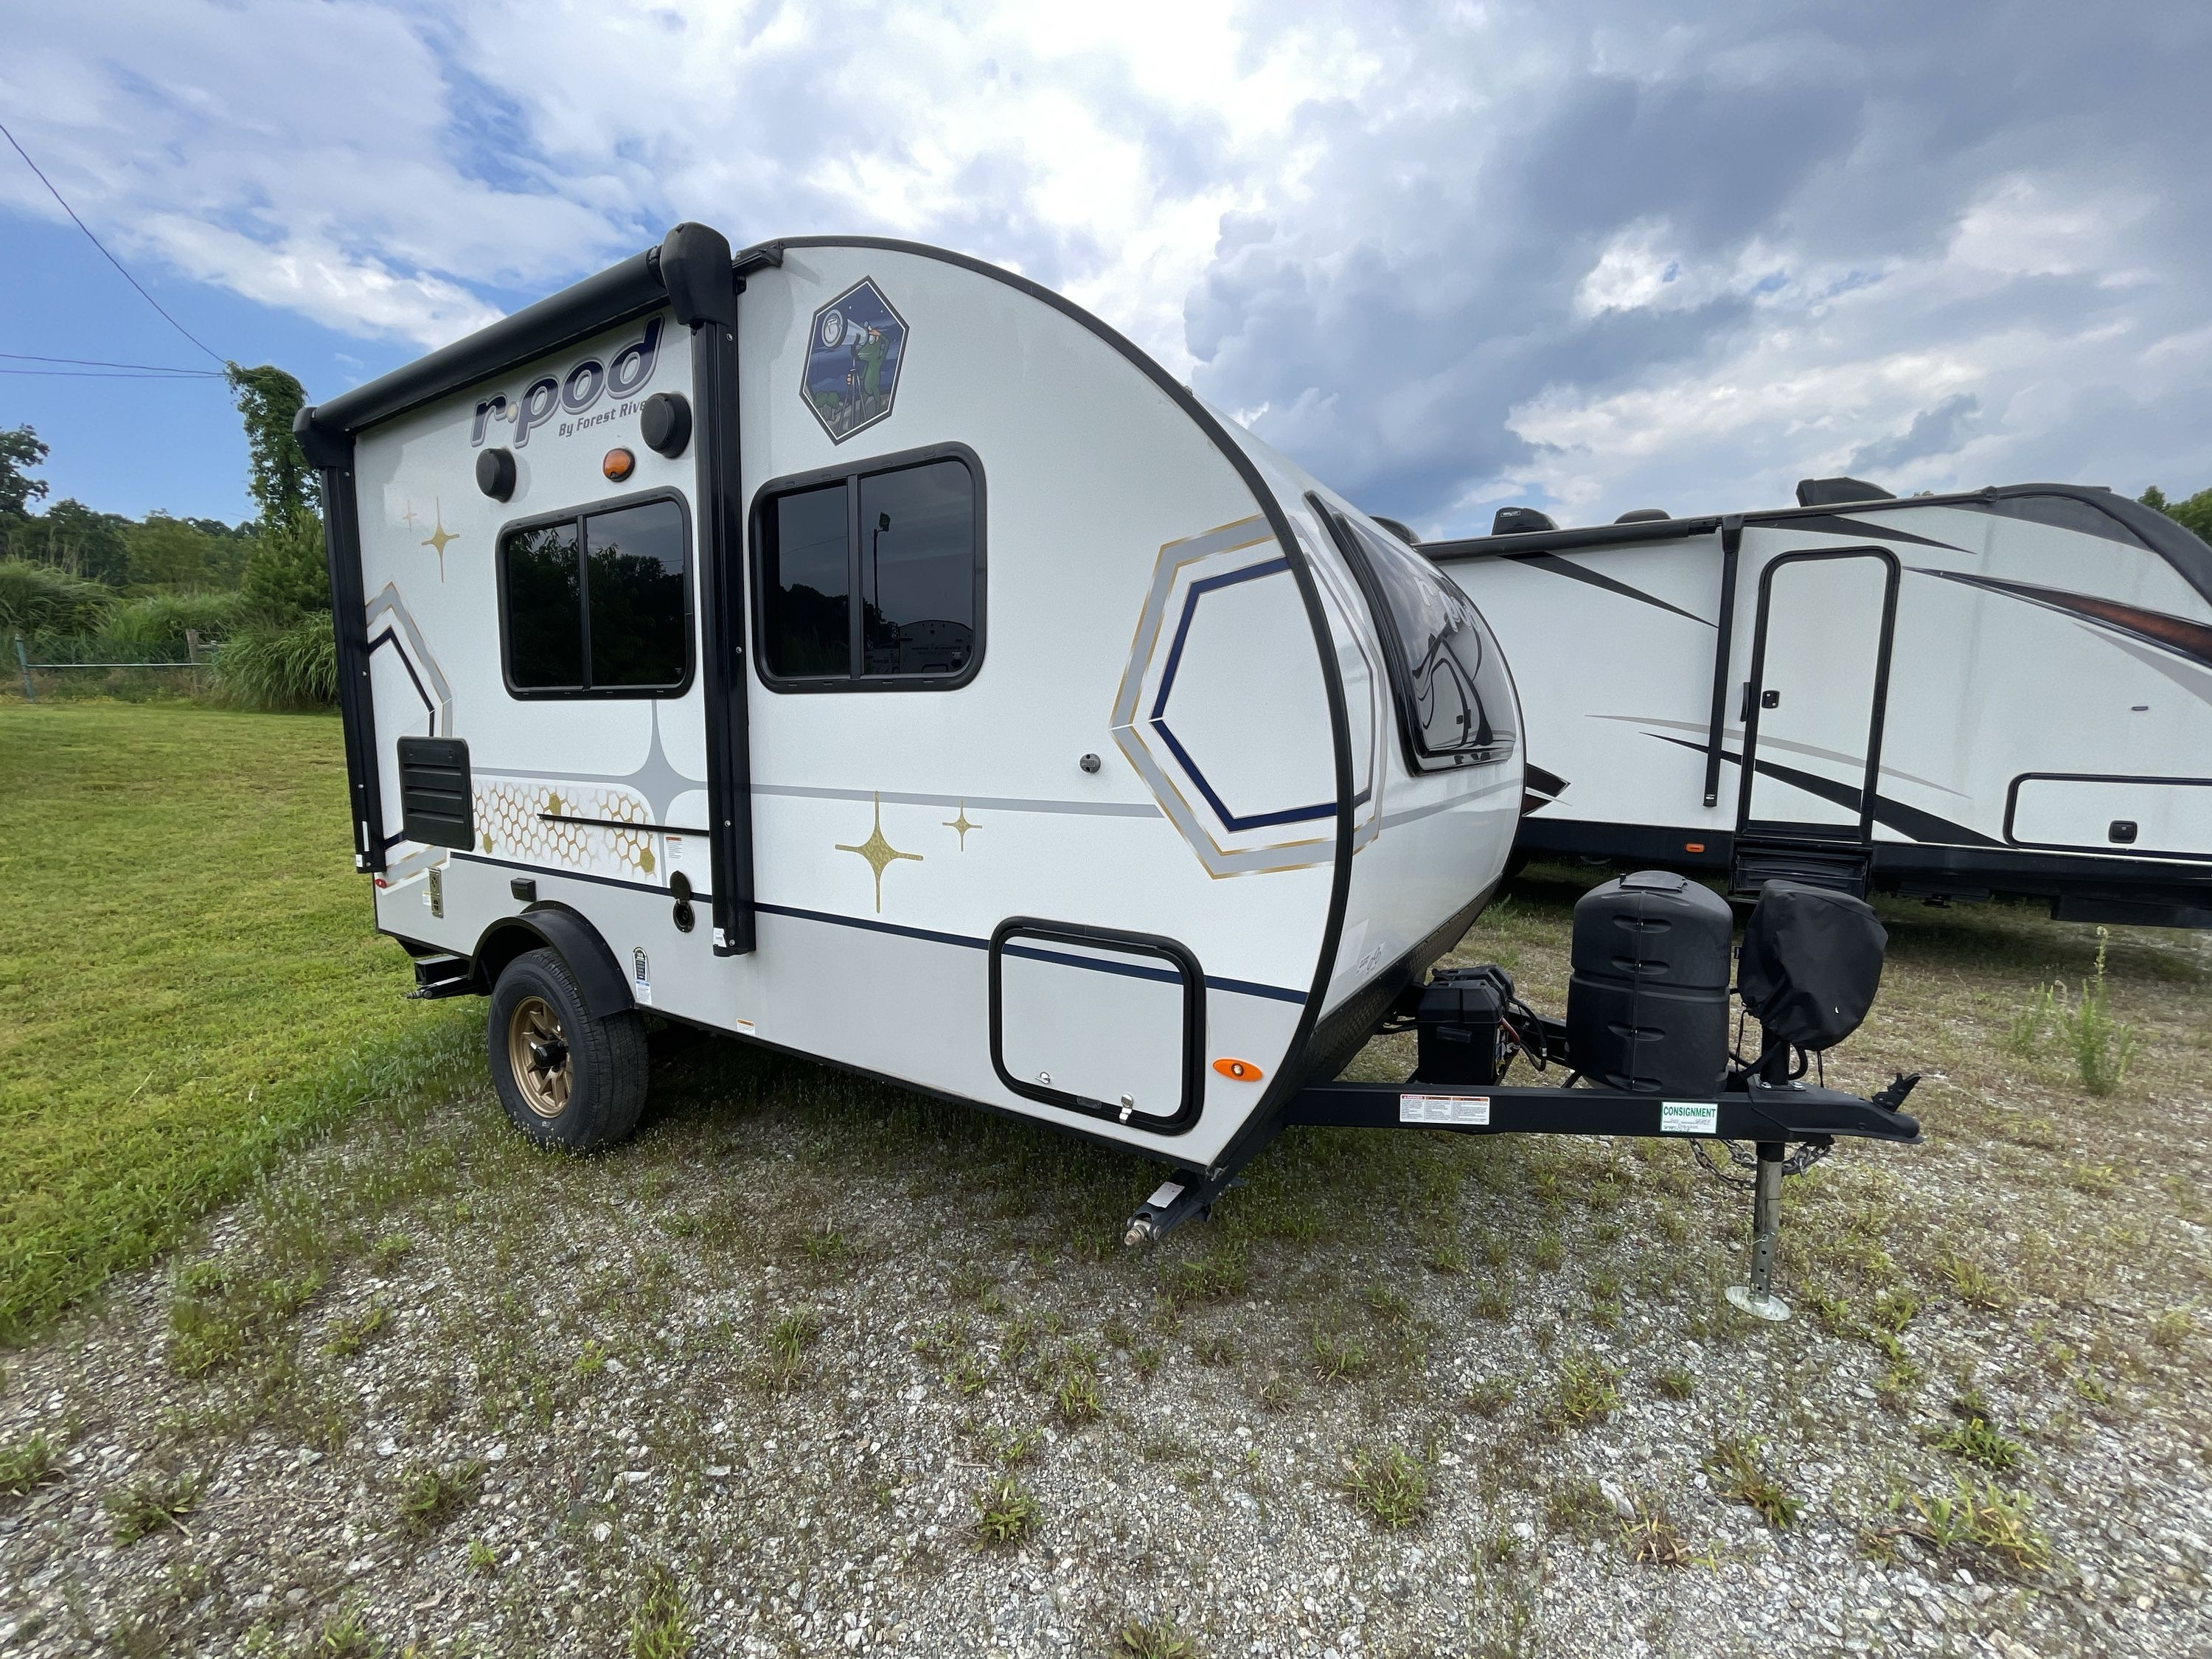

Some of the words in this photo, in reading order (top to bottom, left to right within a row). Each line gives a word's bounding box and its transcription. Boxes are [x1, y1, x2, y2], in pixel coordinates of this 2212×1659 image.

[559, 422, 574, 437] By
[577, 408, 616, 431] Forest
[619, 400, 647, 418] Rive
[1663, 1106, 1717, 1118] CONSIGNMENT
